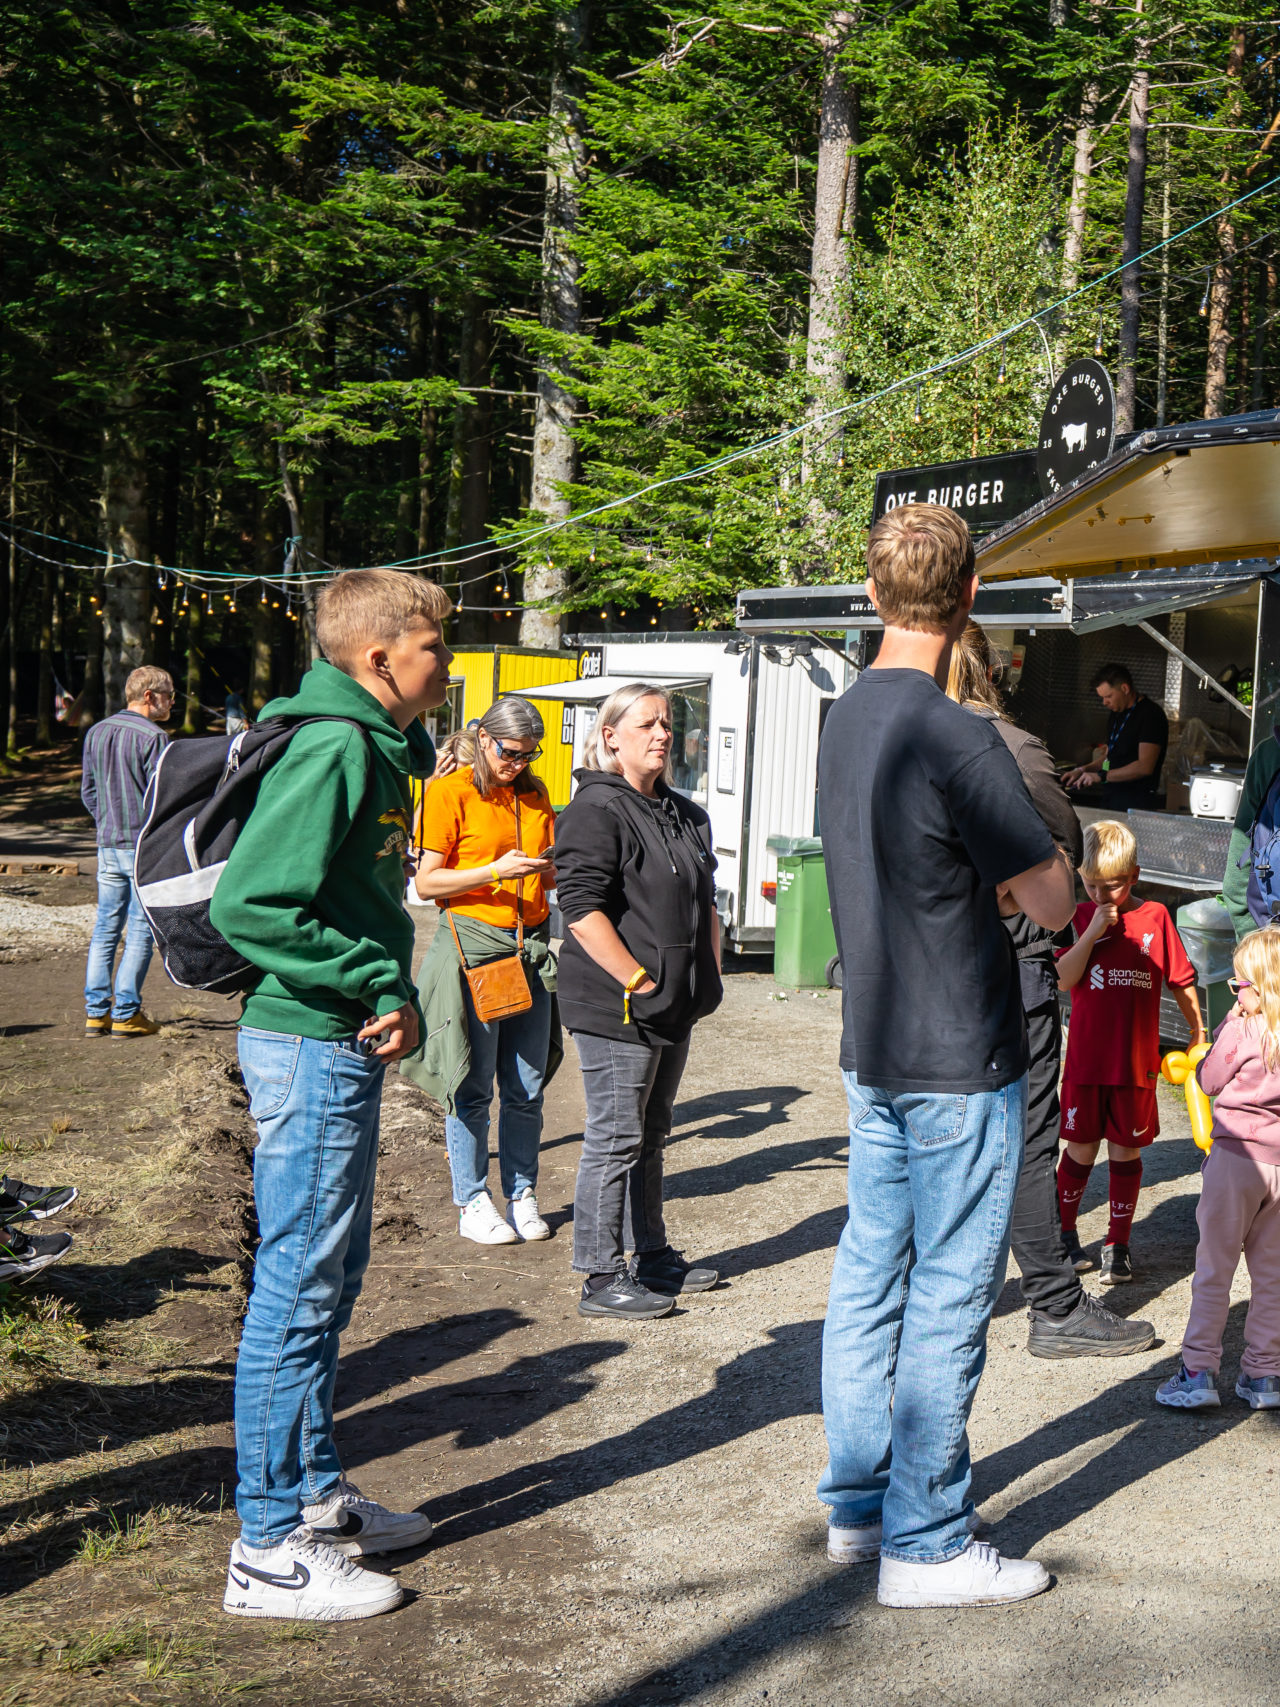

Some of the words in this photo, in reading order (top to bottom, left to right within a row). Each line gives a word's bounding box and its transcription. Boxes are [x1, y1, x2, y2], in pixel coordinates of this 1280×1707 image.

[1072, 373, 1104, 406] BURGER
[1096, 427, 1107, 439] 98
[927, 480, 1004, 509] BURGER
[1108, 968, 1151, 980] standard
[1108, 977, 1152, 989] chartered
[1112, 1200, 1134, 1210] LFC
[236, 1601, 247, 1609] AIR
